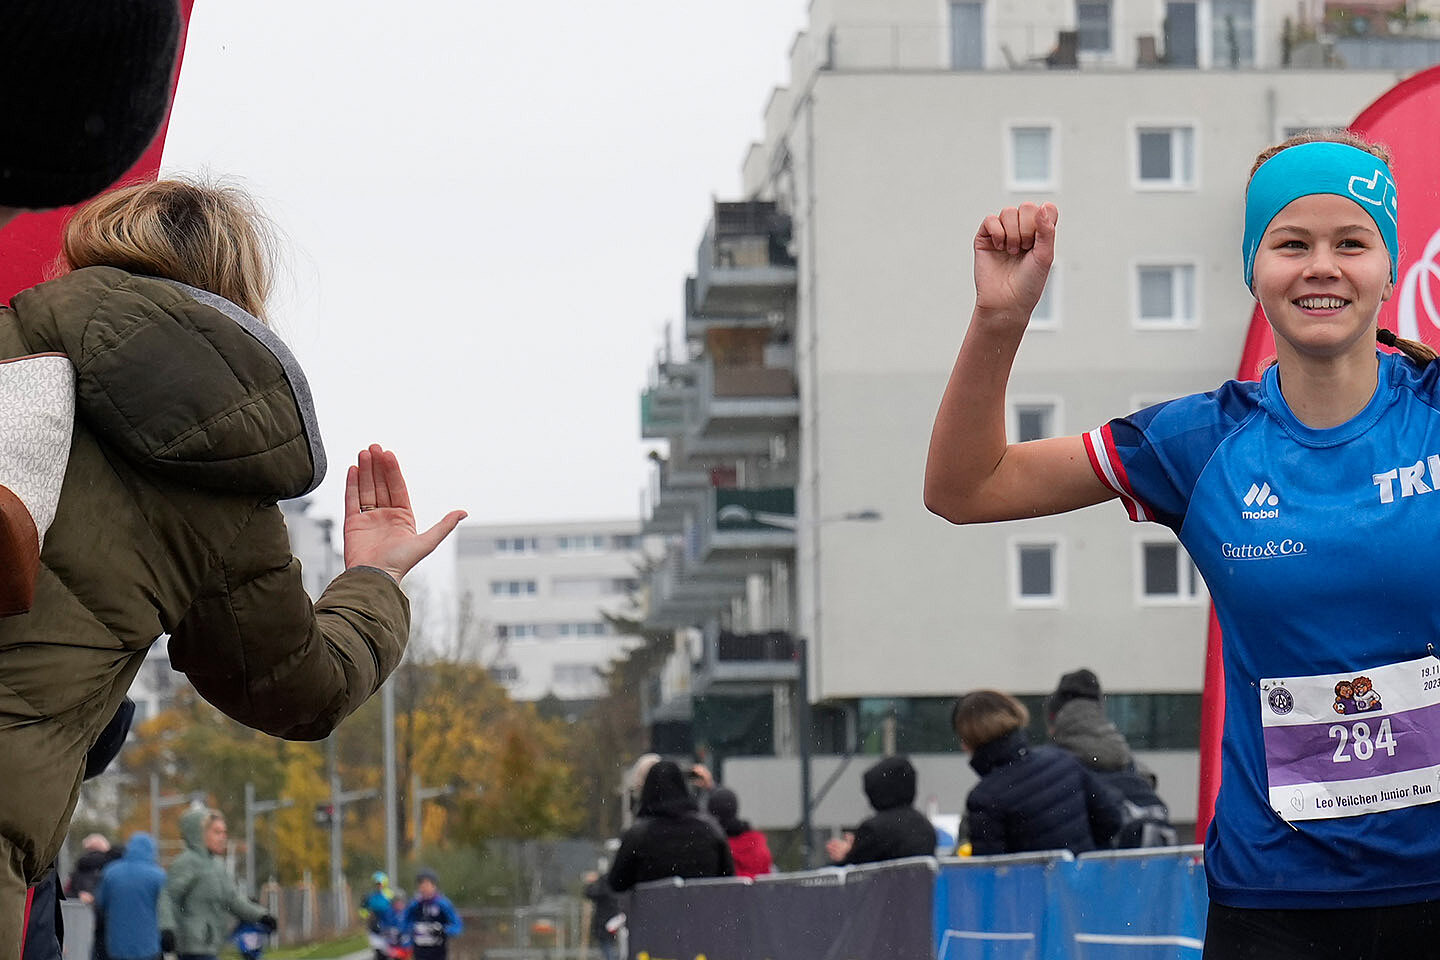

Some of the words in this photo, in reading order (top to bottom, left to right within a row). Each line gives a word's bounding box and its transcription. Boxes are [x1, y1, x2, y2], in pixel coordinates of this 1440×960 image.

[1242, 508, 1279, 520] mobel
[1329, 718, 1397, 763] 284
[1316, 797, 1333, 809] Leo
[1336, 794, 1378, 807] Veilchen
[1380, 787, 1409, 802] Junior
[1412, 783, 1432, 796] Run
